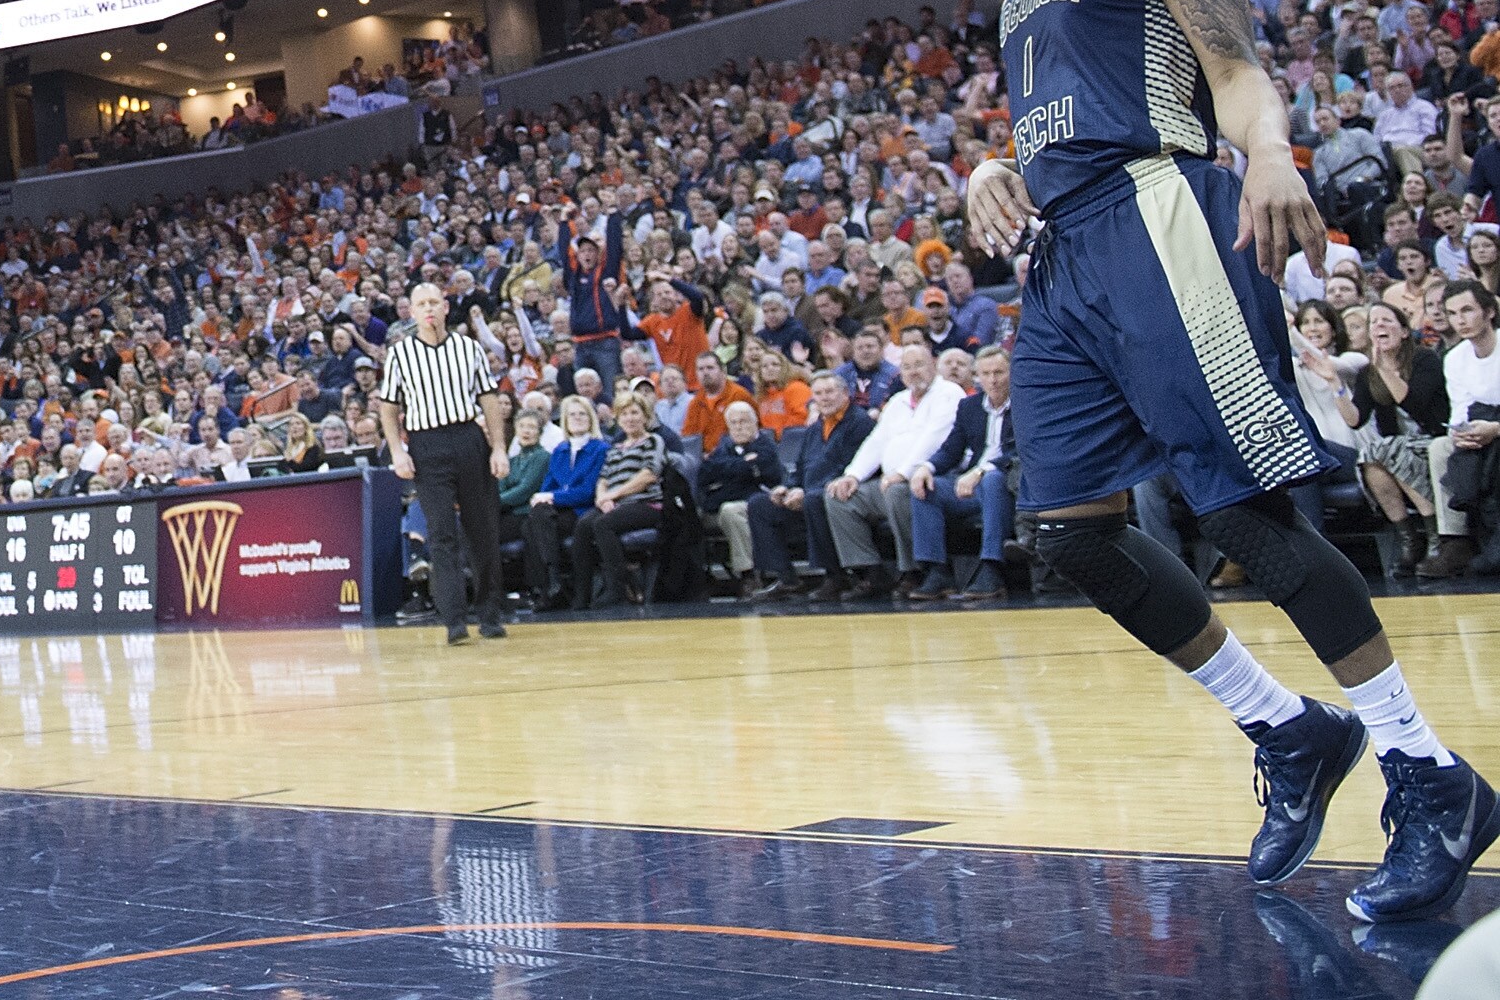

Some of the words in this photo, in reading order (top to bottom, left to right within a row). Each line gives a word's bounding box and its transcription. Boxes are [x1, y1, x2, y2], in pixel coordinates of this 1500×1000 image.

[18, 11, 62, 29] Others
[63, 3, 94, 20] Talk,
[96, 2, 117, 13] We
[1023, 35, 1033, 98] 1
[1241, 416, 1296, 448] GT
[51, 512, 91, 542] 7:45
[6, 537, 27, 562] 16
[49, 543, 78, 562] HALF
[112, 528, 136, 555] 10
[239, 542, 288, 558] McDonald's
[289, 540, 322, 557] proudly
[122, 564, 149, 585] TOL
[239, 561, 277, 577] supports
[277, 558, 310, 575] Virginia
[311, 556, 350, 571] Athletics
[93, 592, 103, 613] 3
[118, 590, 153, 611] FOUL
